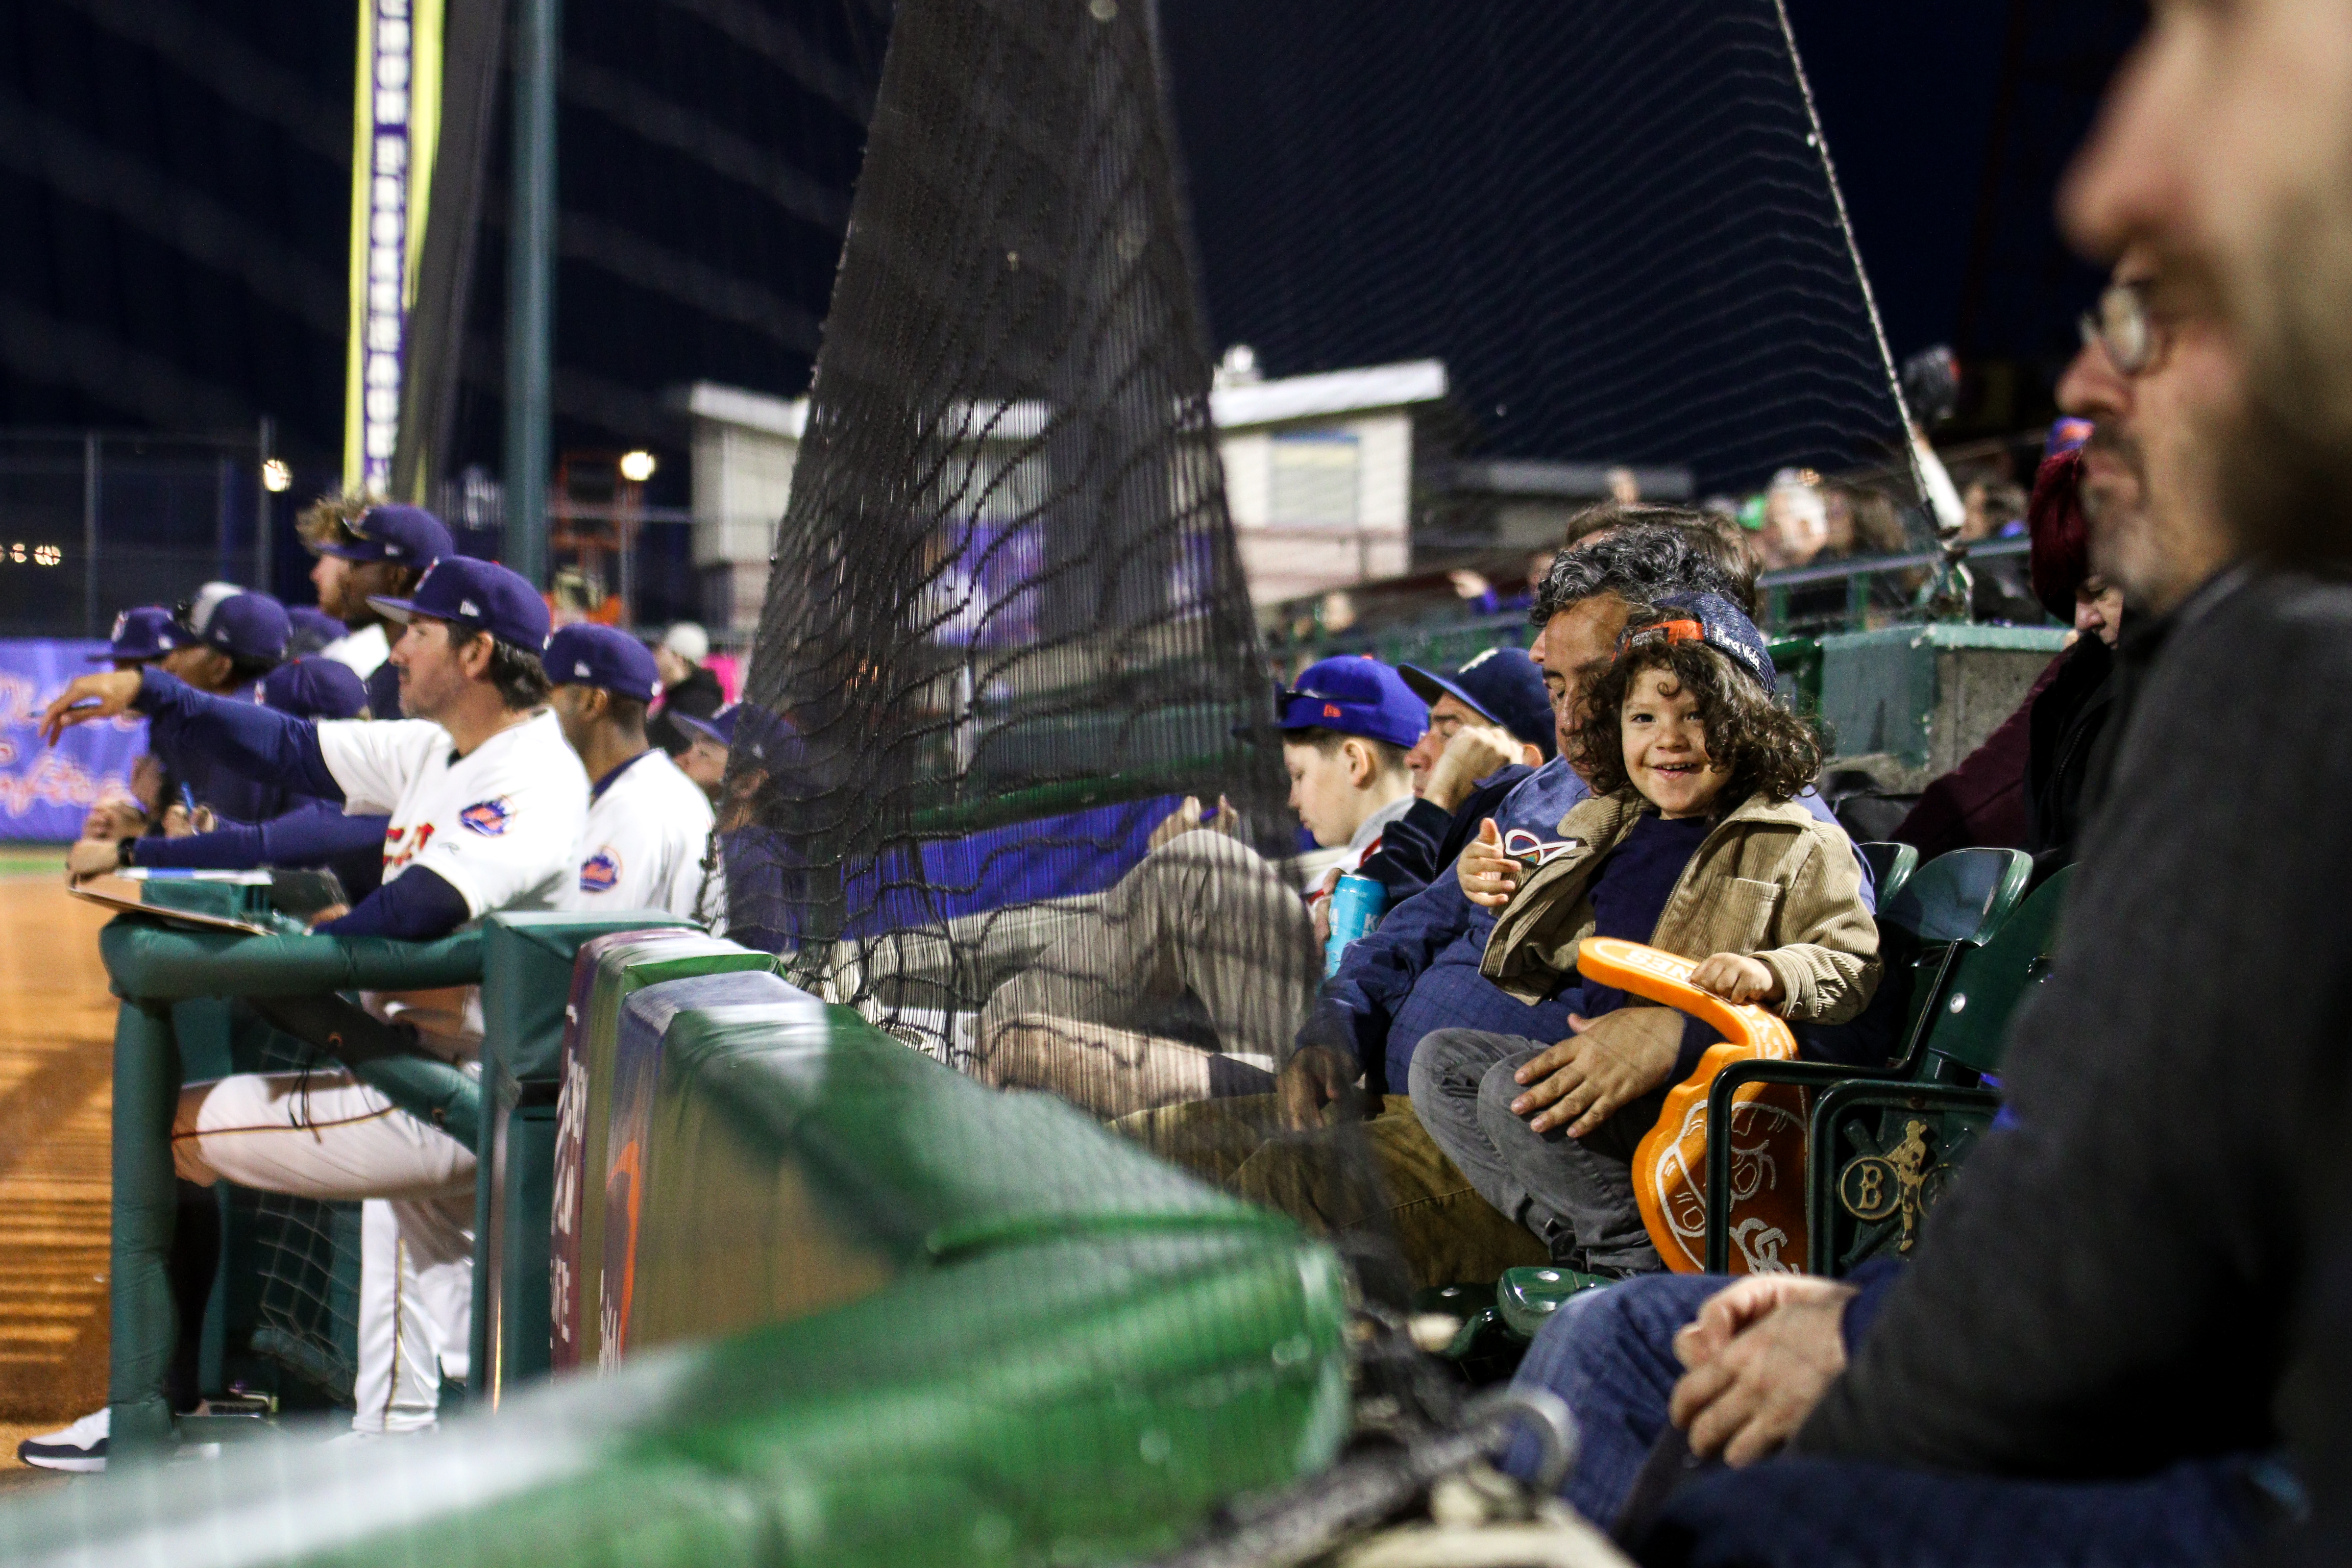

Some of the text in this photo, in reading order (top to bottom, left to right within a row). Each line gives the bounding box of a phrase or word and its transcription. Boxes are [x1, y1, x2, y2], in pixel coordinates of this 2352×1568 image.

[1715, 628, 1760, 670] Pura Vida
[1857, 1164, 1884, 1209] B
